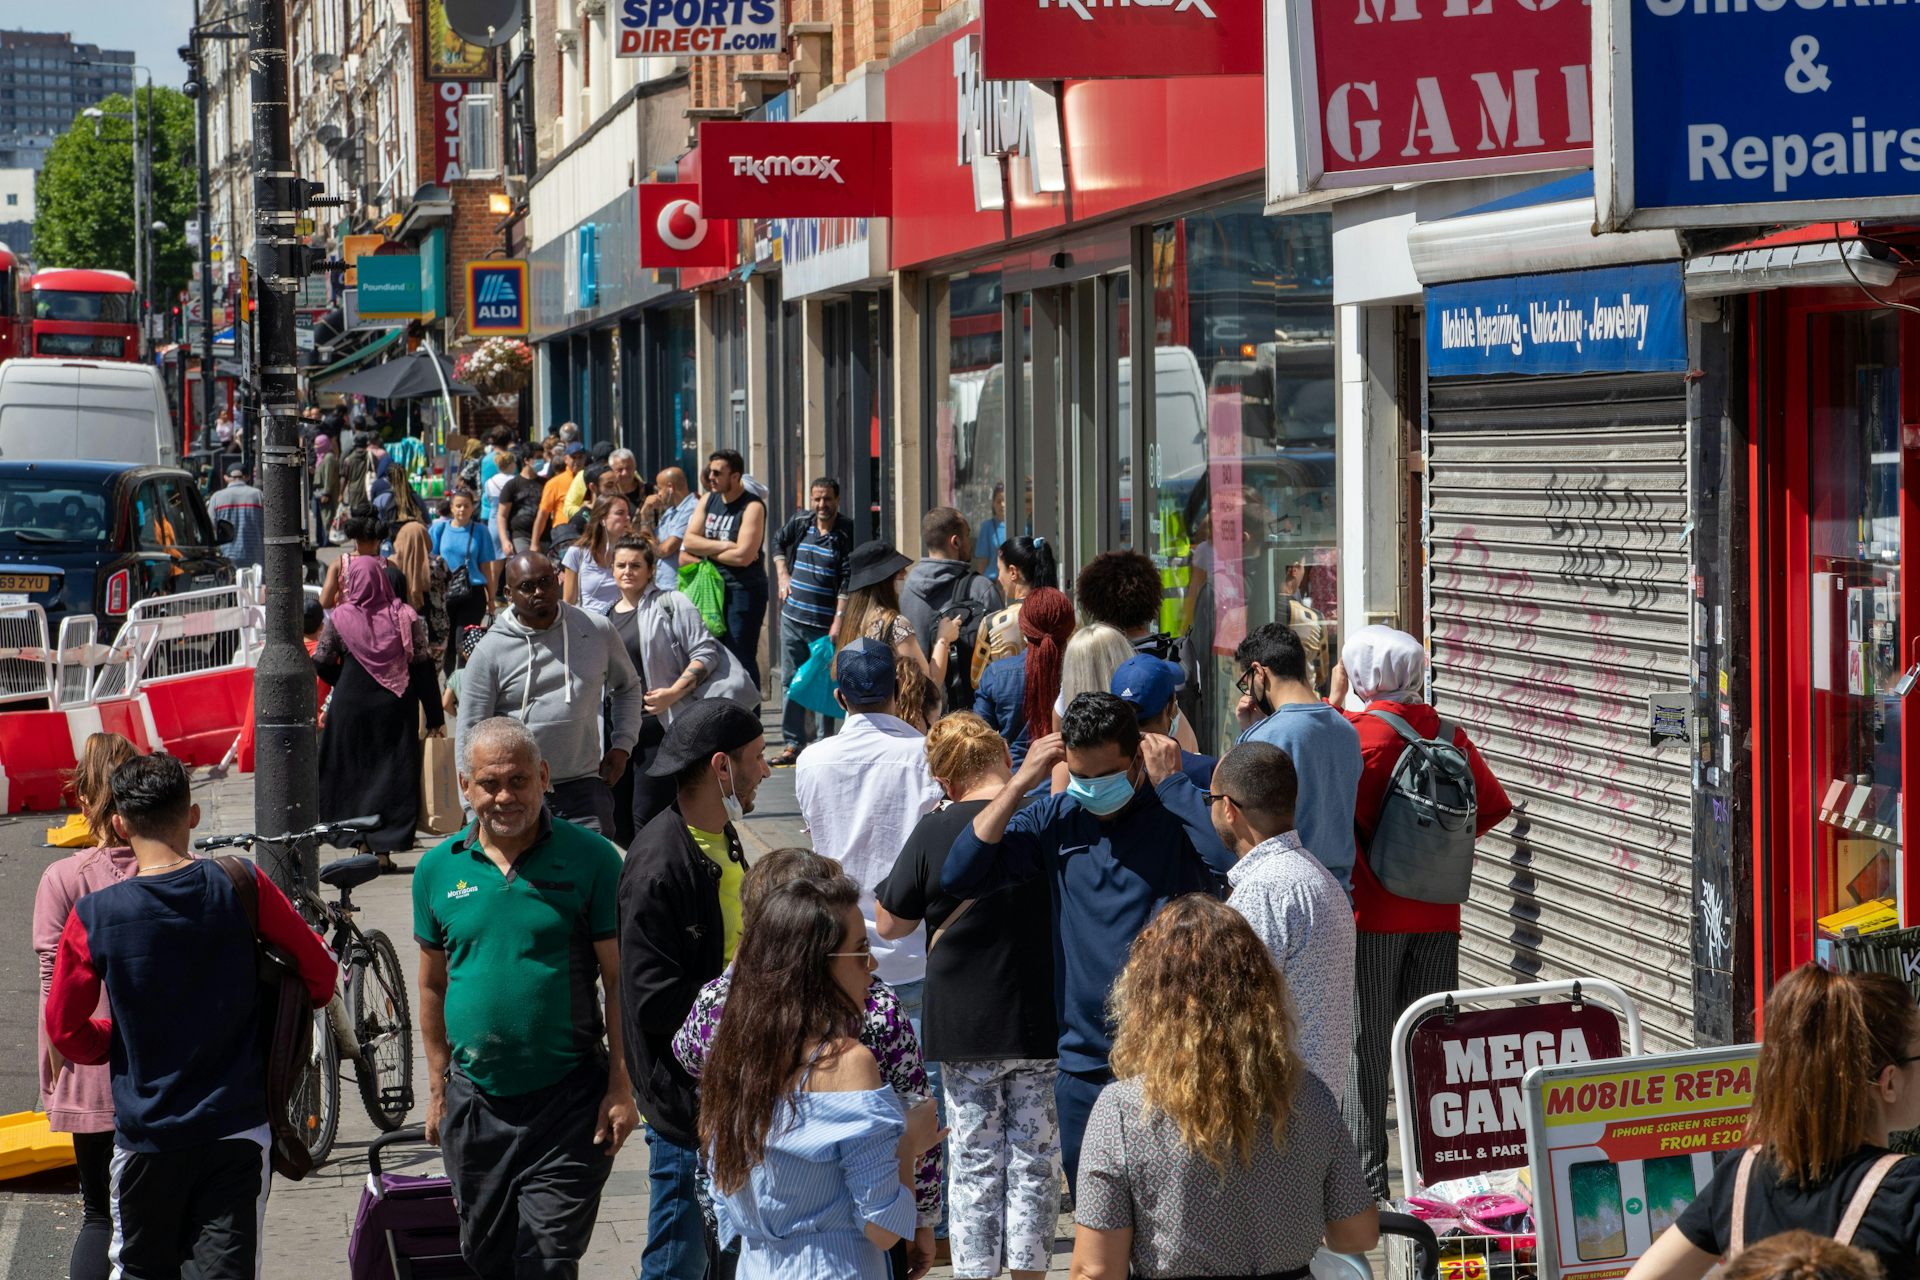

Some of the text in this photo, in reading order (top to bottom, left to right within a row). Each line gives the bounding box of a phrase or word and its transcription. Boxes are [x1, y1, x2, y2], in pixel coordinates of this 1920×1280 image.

[621, 0, 775, 28] SPORTS
[620, 27, 777, 54] DIRECT.COM
[1784, 34, 1832, 94] &
[1687, 116, 1920, 193] Repairs
[362, 283, 405, 291] Poundland
[478, 305, 517, 319] ALDI
[1442, 307, 1475, 349] Mobile
[1475, 303, 1523, 357] Repairing
[1530, 299, 1582, 353] Unlocking
[1589, 293, 1649, 351] Jewellery
[18, 577, 43, 589] ZYU
[1443, 1028, 1591, 1085] MEGA
[1547, 1076, 1665, 1116] MOBILE
[1612, 1124, 1654, 1138] IPHONE
[1656, 1121, 1700, 1133] SCREEN
[1660, 1129, 1742, 1151] FROM £20
[1435, 1149, 1472, 1163] SELL
[1476, 1147, 1487, 1159] &
